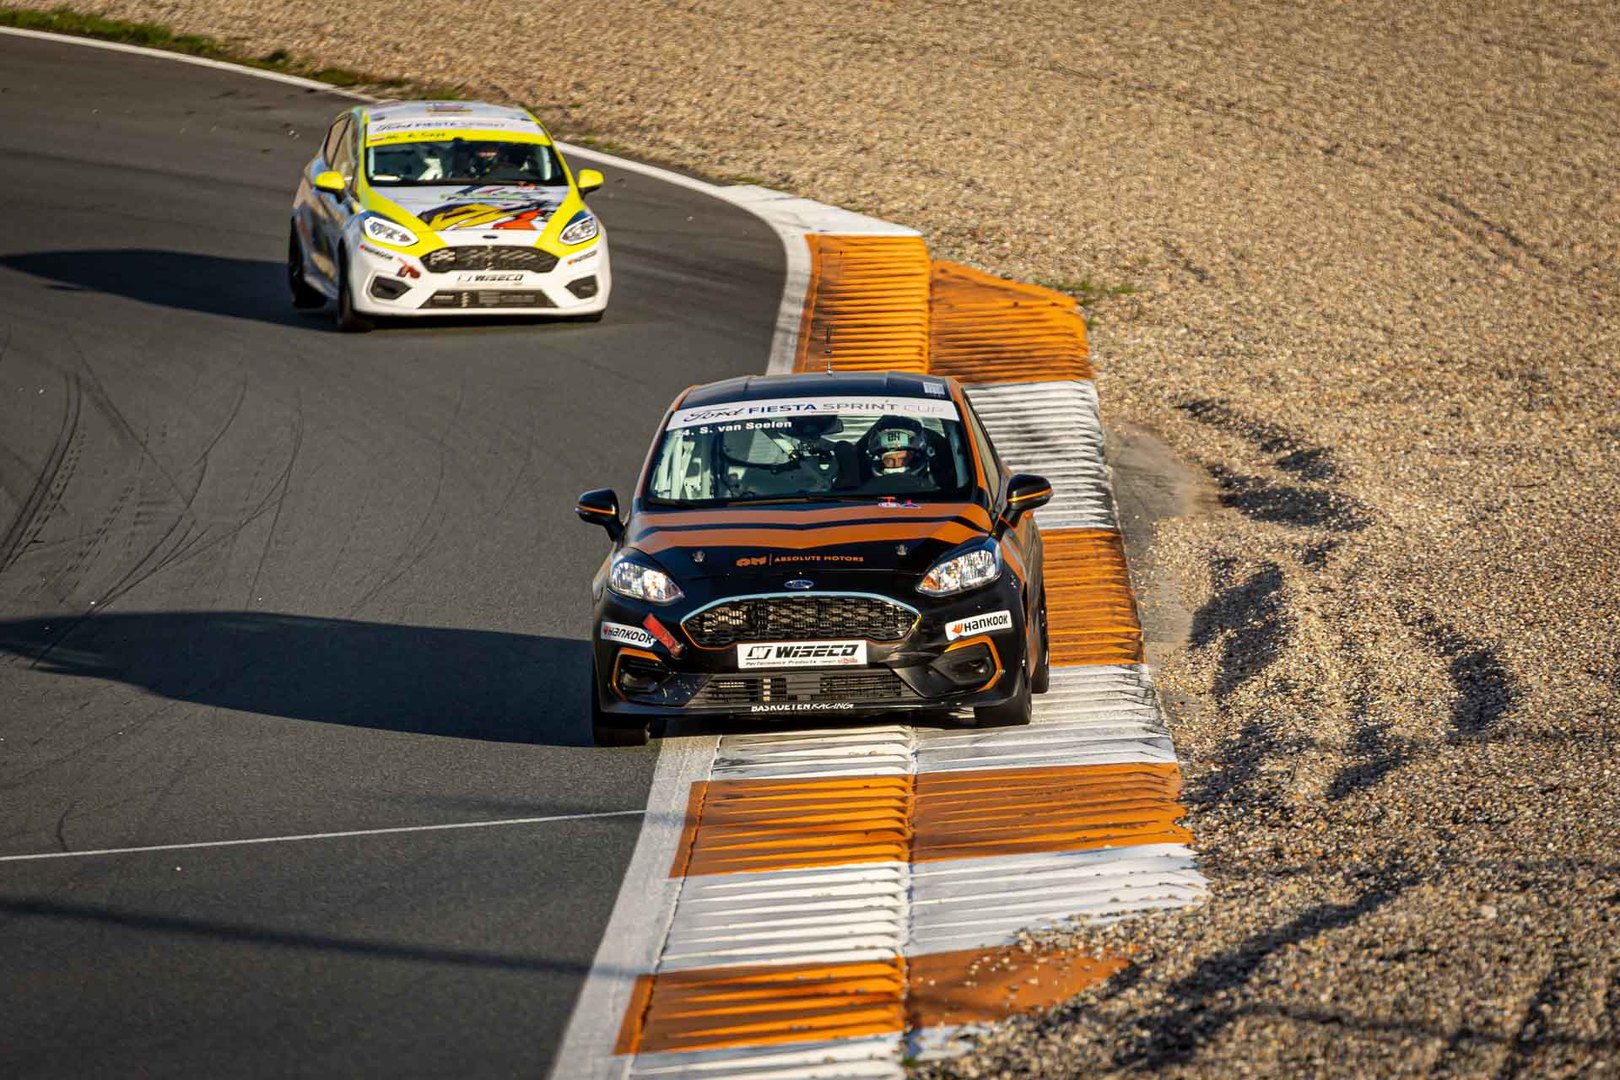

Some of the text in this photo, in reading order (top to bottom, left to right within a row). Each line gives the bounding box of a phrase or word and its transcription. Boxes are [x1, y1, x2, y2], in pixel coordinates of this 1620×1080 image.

[683, 402, 944, 422] Ford FIESTA SPRINT CUP
[699, 426, 713, 435] S.
[717, 424, 741, 433] van
[745, 421, 792, 430] Soelen
[774, 555, 821, 563] ABSOLUTE
